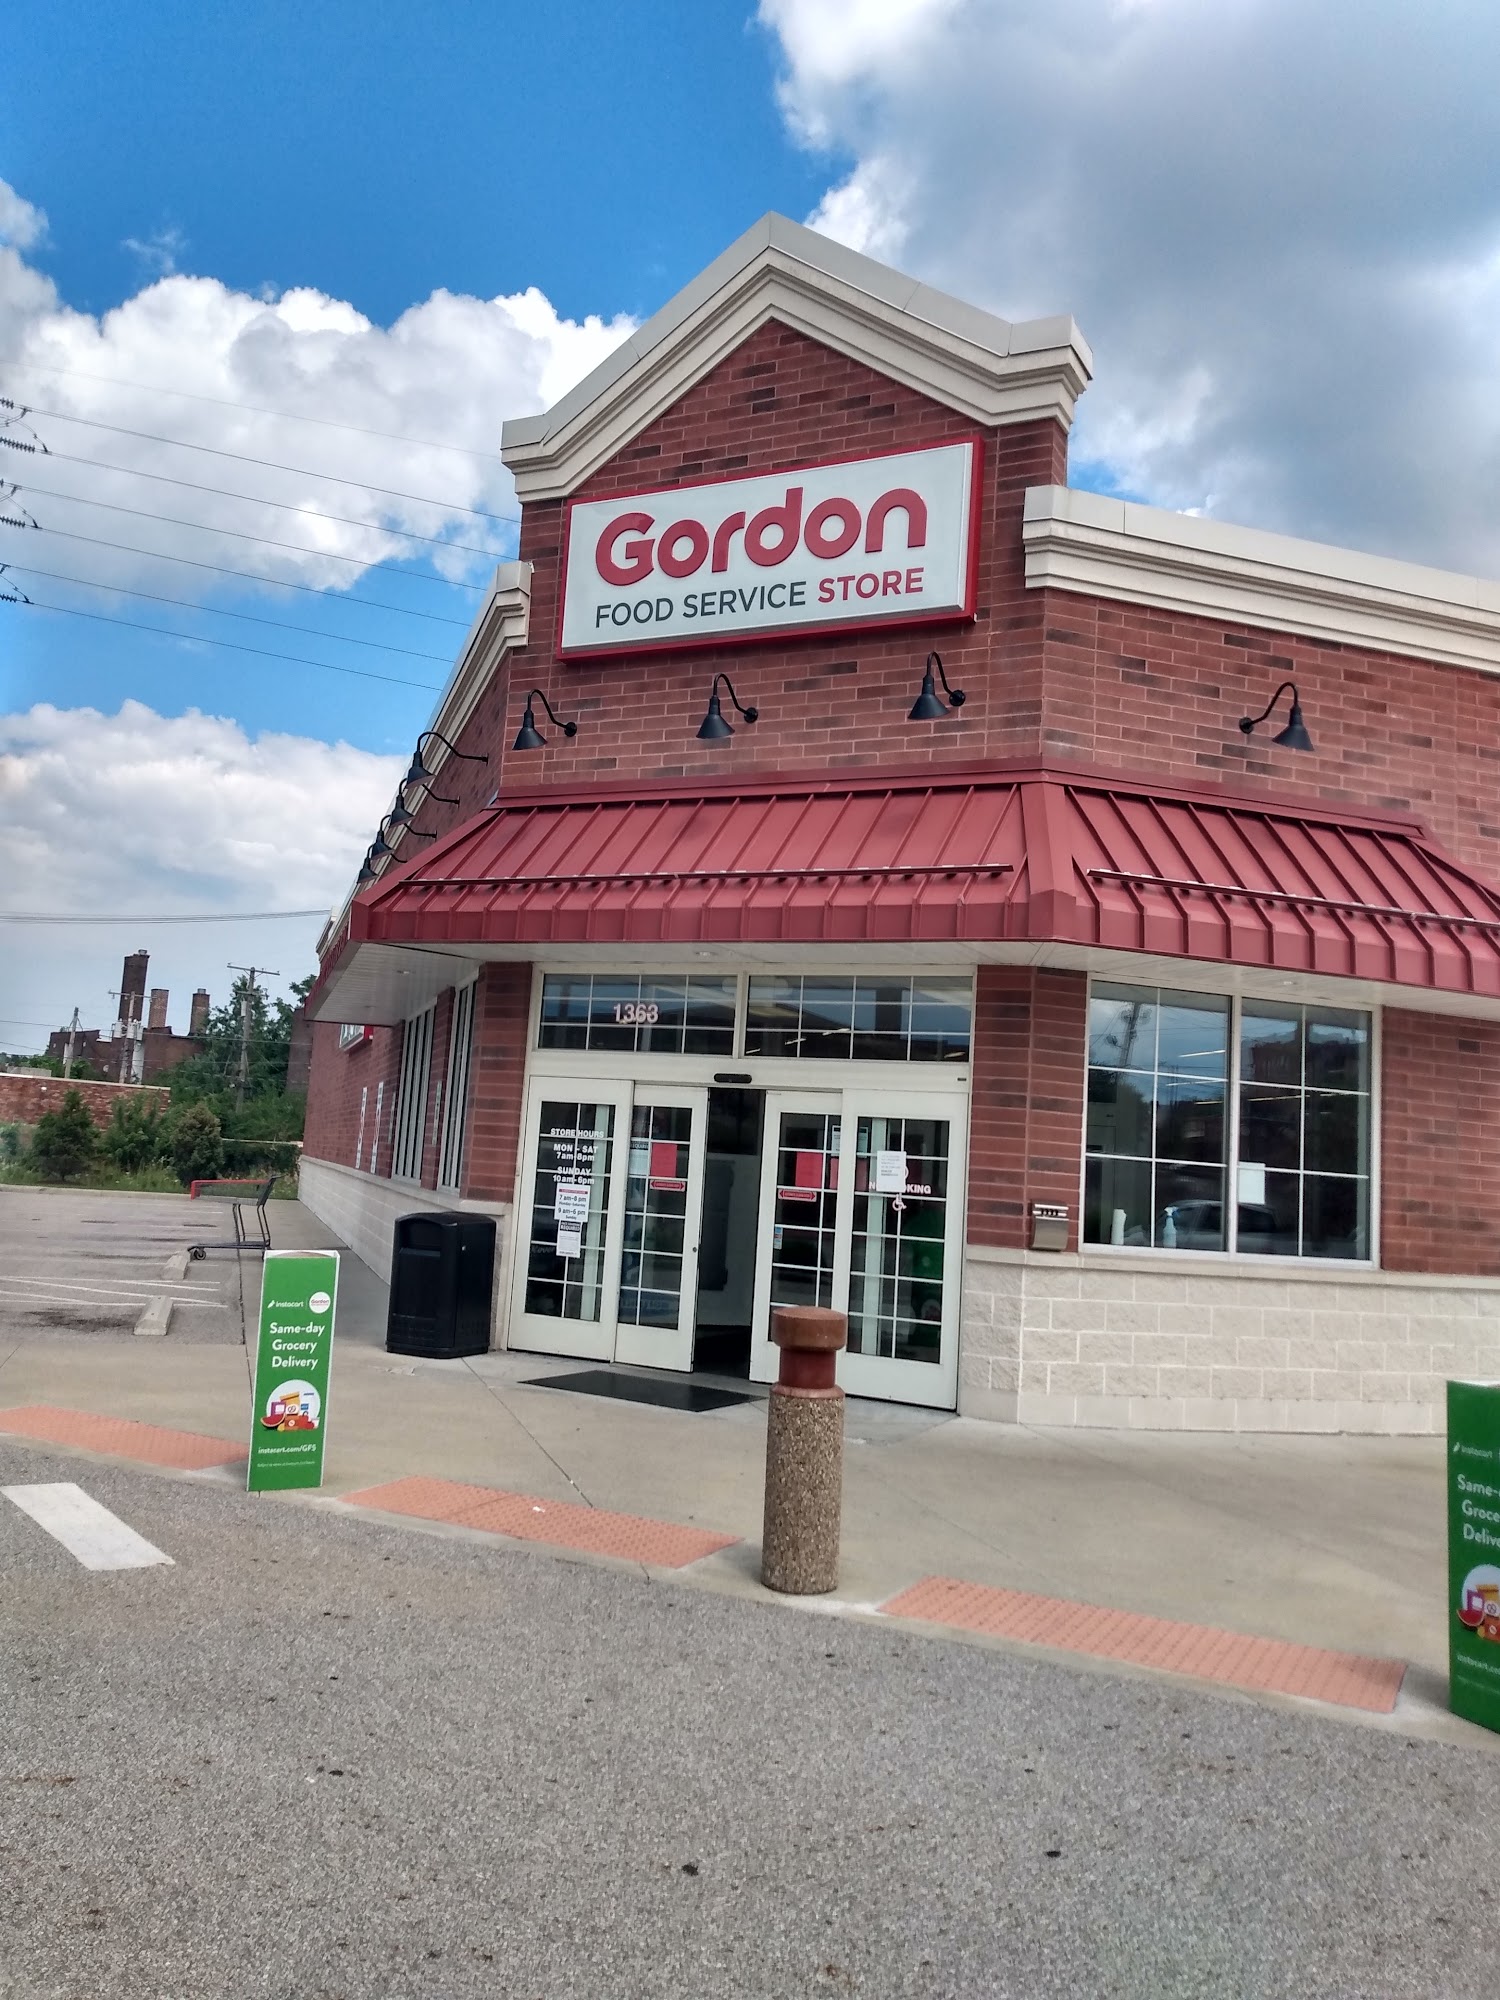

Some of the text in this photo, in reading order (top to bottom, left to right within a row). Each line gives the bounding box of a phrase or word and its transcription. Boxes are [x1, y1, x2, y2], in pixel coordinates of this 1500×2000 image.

[595, 487, 928, 587] Gordon
[595, 567, 925, 629] FOOD SERVICE STORE
[613, 1002, 659, 1024] 1363
[550, 1127, 604, 1138] STORE HOURS
[553, 1143, 573, 1152] MON
[582, 1145, 599, 1154] SAT
[557, 1166, 592, 1176] SUNDAY
[275, 1300, 304, 1308] instacart
[269, 1321, 325, 1338] Same-day
[271, 1338, 318, 1354] Grocery
[271, 1355, 319, 1371] Delivery
[1457, 1473, 1500, 1497] Same-
[1461, 1499, 1500, 1523] Groce
